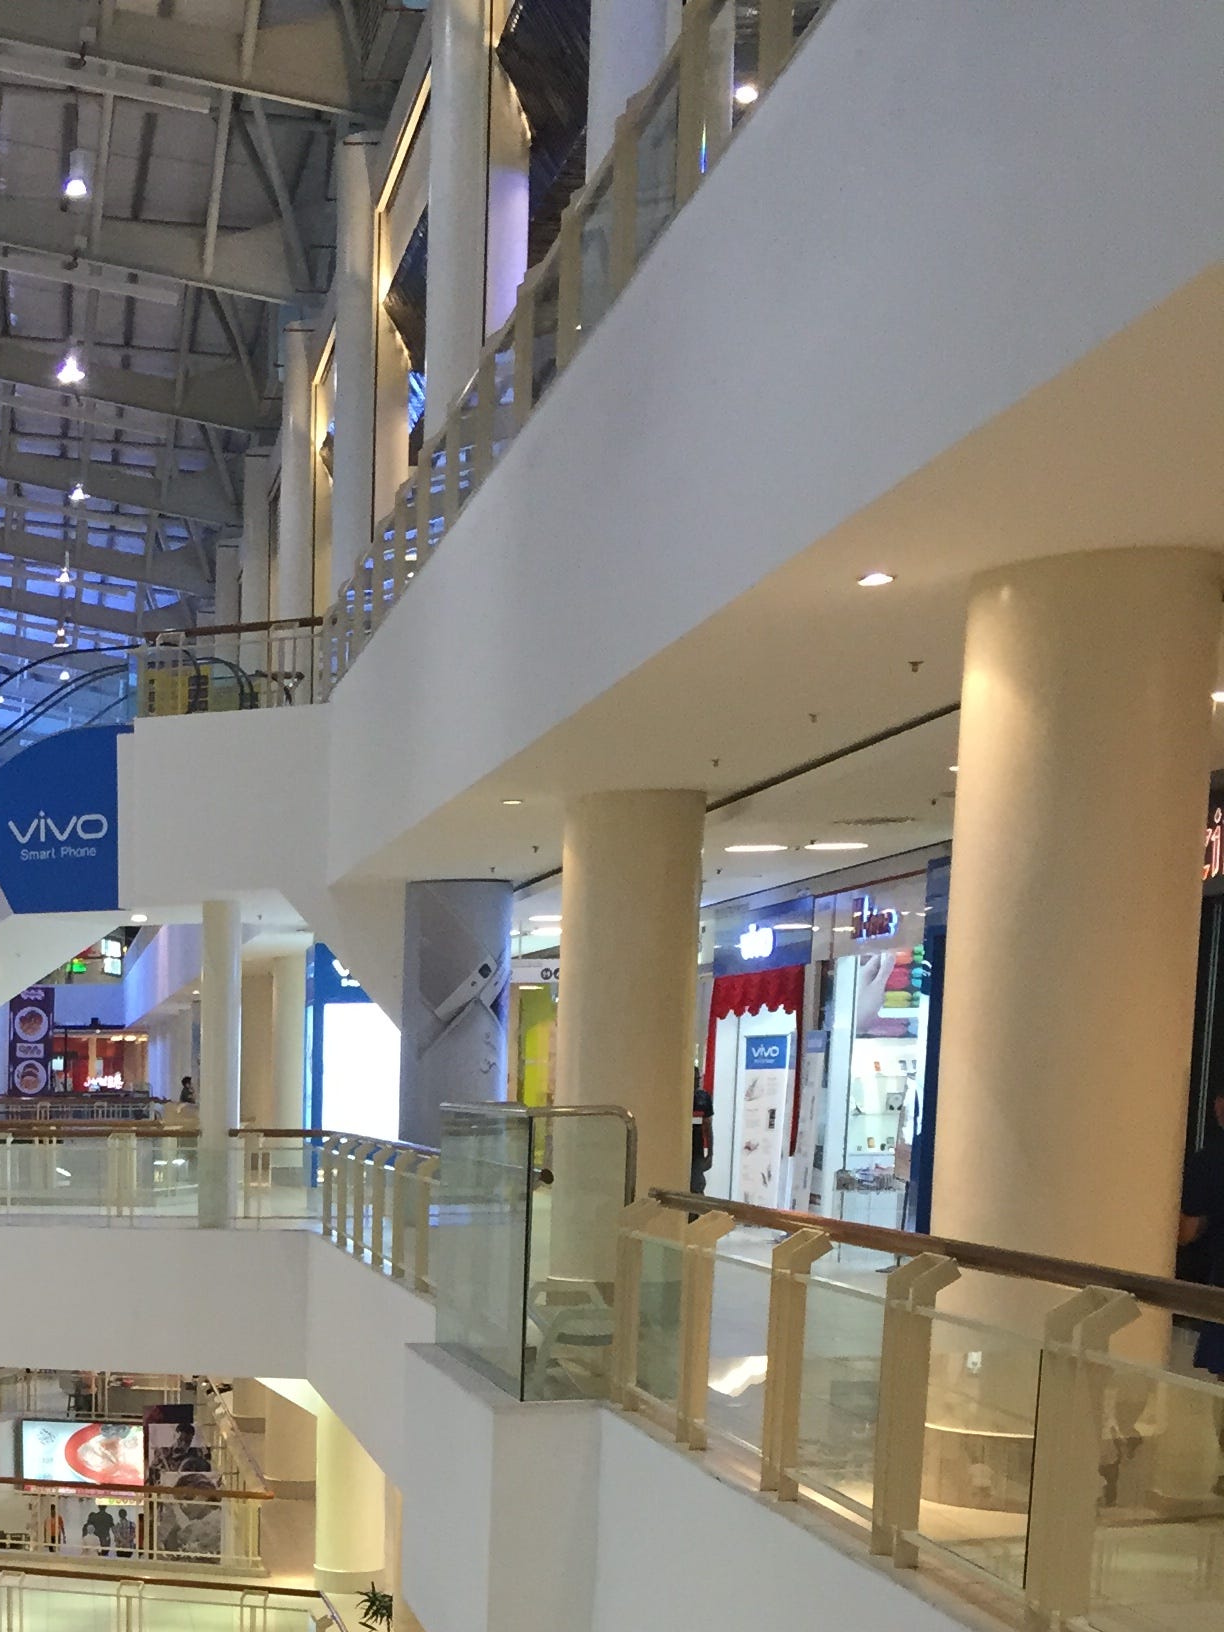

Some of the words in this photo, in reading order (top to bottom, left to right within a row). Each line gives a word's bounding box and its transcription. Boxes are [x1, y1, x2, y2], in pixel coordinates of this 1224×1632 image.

[8, 810, 108, 844] vivo
[20, 847, 56, 861] Smart
[60, 846, 97, 858] Phone
[751, 1044, 780, 1057] vivo
